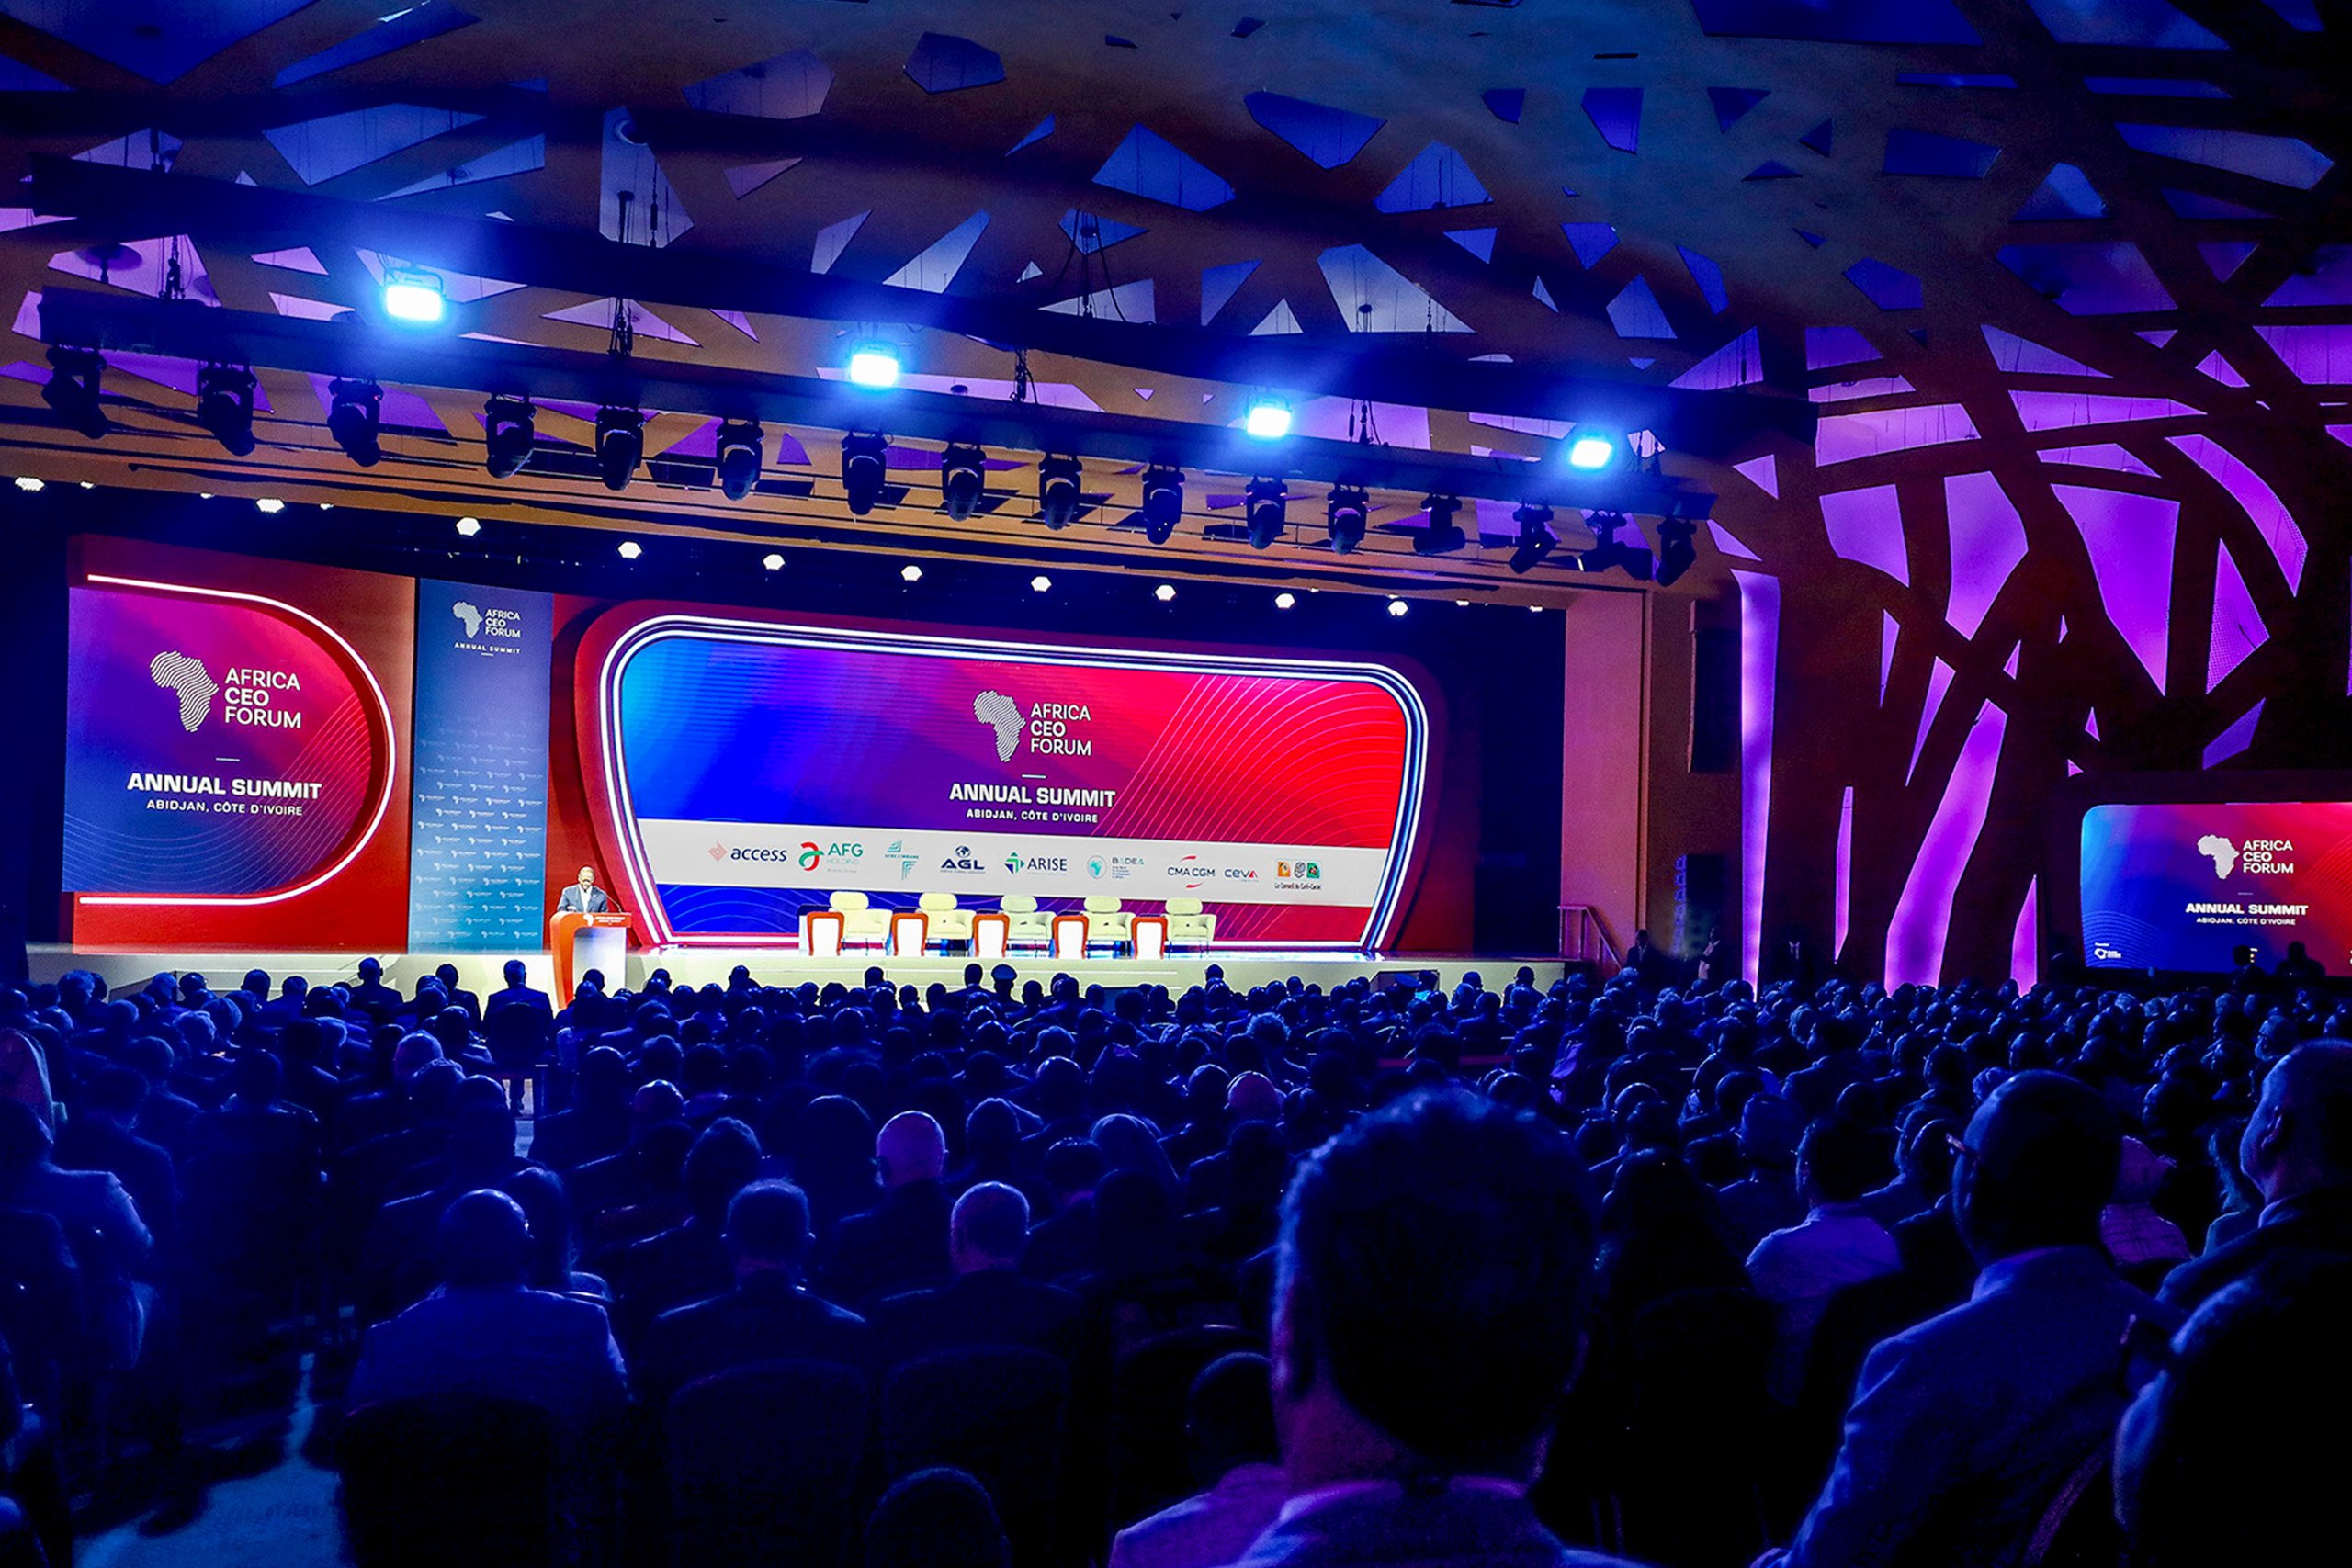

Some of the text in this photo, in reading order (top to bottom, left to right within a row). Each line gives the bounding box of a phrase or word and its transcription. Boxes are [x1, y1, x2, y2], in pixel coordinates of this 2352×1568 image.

[485, 609, 521, 621] AFRICA
[485, 617, 506, 627] CEO
[485, 626, 521, 637] FORUM
[454, 642, 521, 654] ANNUAL SUMMIT
[224, 667, 300, 691] AFRICA
[224, 687, 270, 706] CEO
[224, 706, 301, 728] FORUM
[1030, 702, 1091, 721] AFRICA
[1030, 720, 1066, 737] CEO
[1030, 738, 1091, 756] FORUM
[127, 773, 322, 799] ANNUAL SUMMIT
[949, 783, 1116, 807] ANNUAL SUMMIT
[146, 799, 303, 817] ABIDJAN, CÔTE D'IVOIRE
[967, 808, 1098, 823] ABIDJAN, CÔTE D'IVOIRE
[828, 842, 864, 857] AFG
[2243, 840, 2293, 851] AFRICA
[730, 848, 788, 862] access
[2243, 852, 2273, 862] CEO
[941, 858, 985, 870] AGL
[1027, 857, 1068, 872] ARISE
[2243, 863, 2294, 874] FORUM
[1167, 867, 1215, 877] CMA CGM
[2186, 903, 2309, 916] ANNUAL SUMMIT
